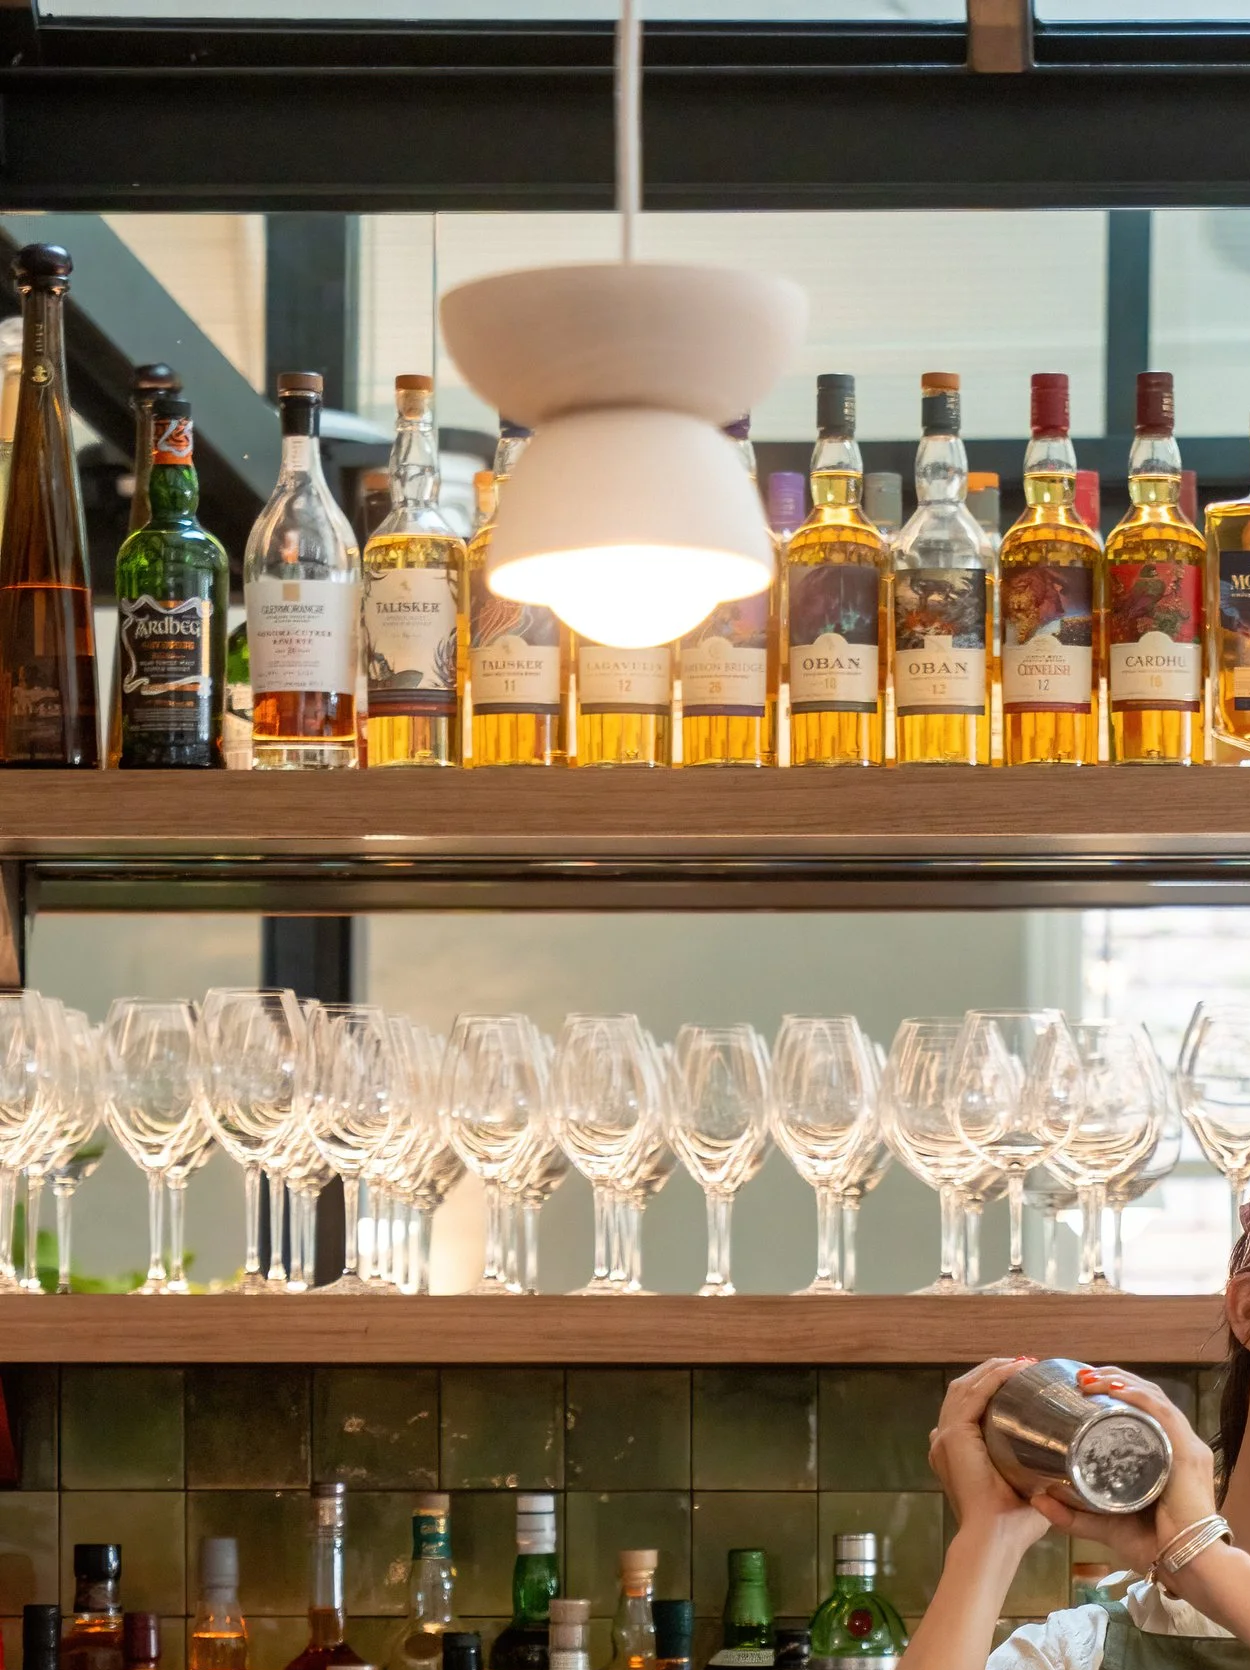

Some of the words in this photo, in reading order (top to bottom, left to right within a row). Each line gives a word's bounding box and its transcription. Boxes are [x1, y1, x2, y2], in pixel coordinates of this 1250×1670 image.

[376, 602, 440, 614] TALISKER
[482, 660, 543, 671] TALISKER
[802, 657, 862, 670] OBAN
[1126, 656, 1189, 667] CARDHU
[908, 663, 969, 675] OBAN
[1038, 679, 1050, 691] 12
